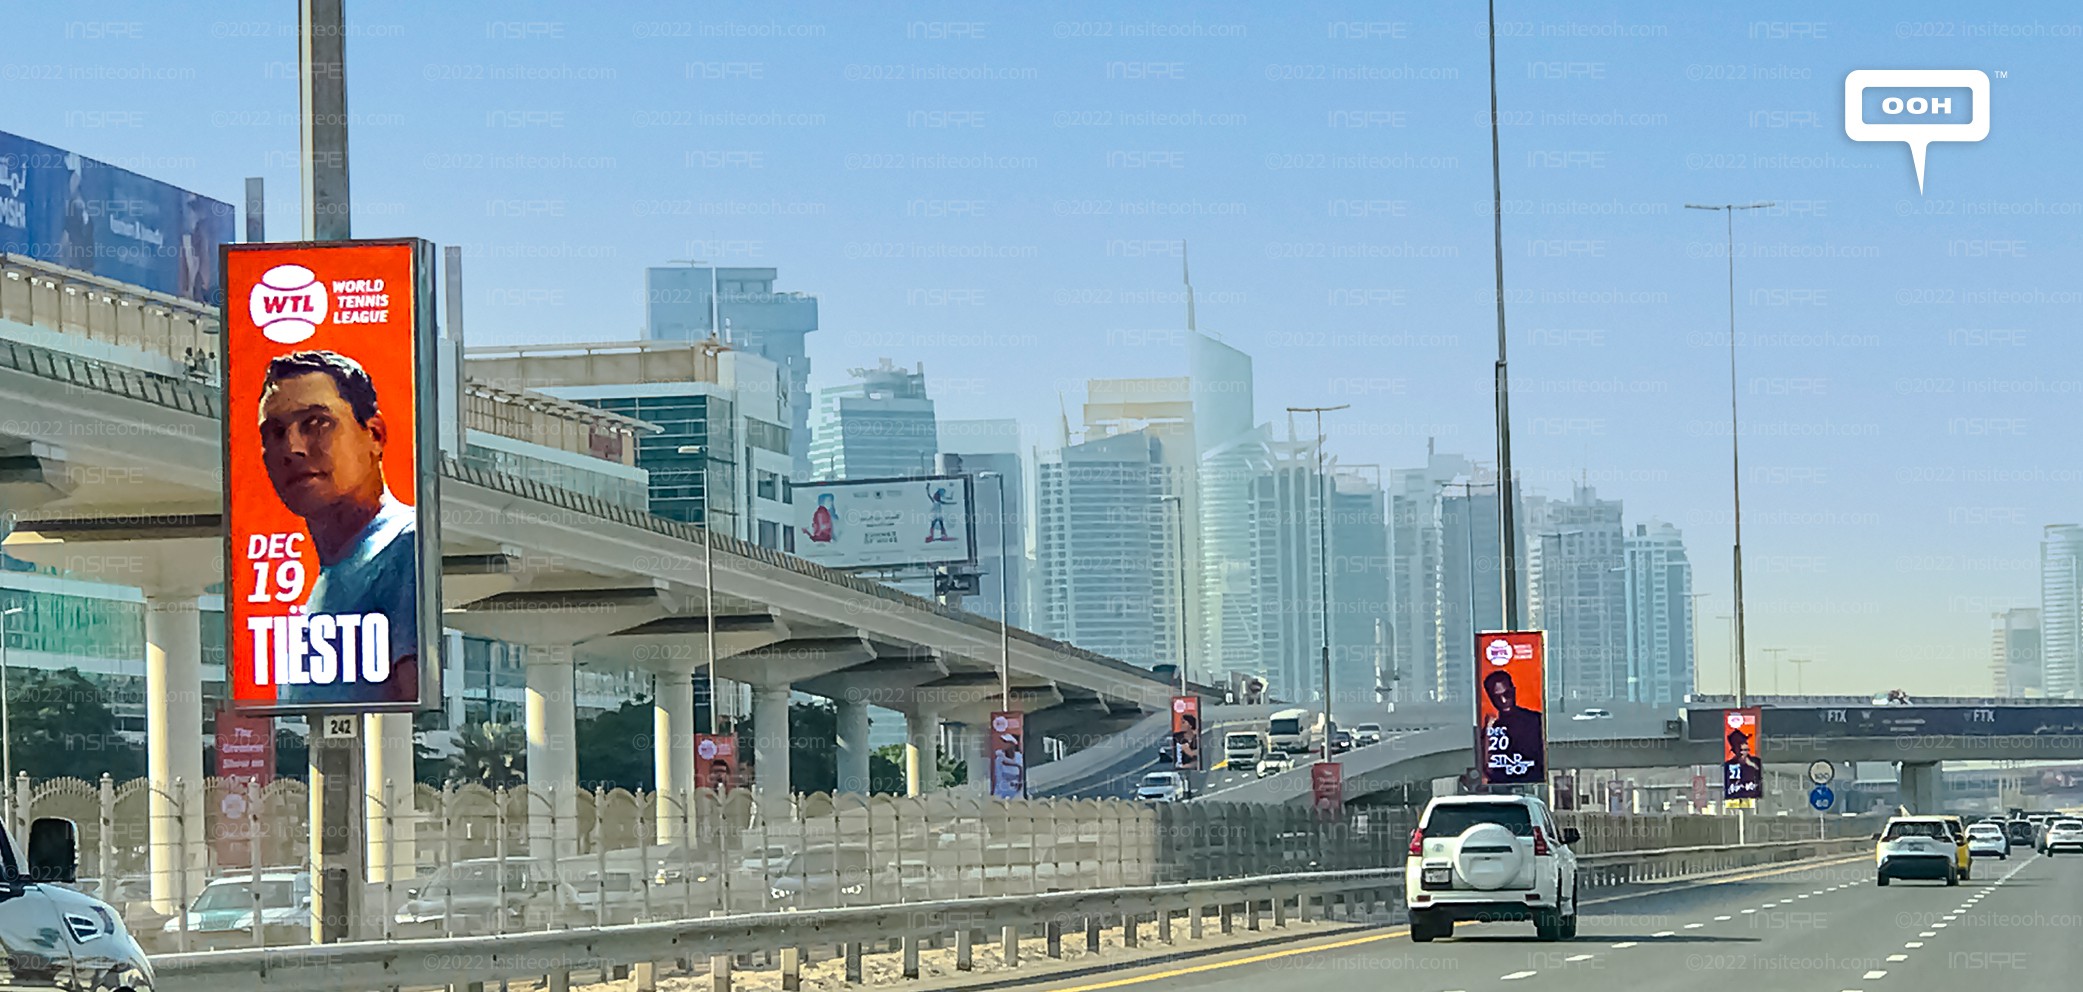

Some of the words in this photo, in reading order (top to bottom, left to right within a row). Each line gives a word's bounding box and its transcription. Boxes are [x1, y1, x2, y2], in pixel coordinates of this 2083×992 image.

[332, 279, 384, 293] WORLD
[264, 296, 314, 314] WTL
[337, 294, 389, 309] TENNIS
[333, 310, 388, 324] LEAGUE
[247, 533, 305, 559] DEC
[247, 561, 305, 603] 19
[248, 605, 390, 685] TIËSTO
[1828, 710, 1847, 722] FTX
[1974, 710, 1995, 722] FTX
[330, 720, 351, 734] 242
[1486, 727, 1507, 736] DEC
[1488, 736, 1509, 750] 20
